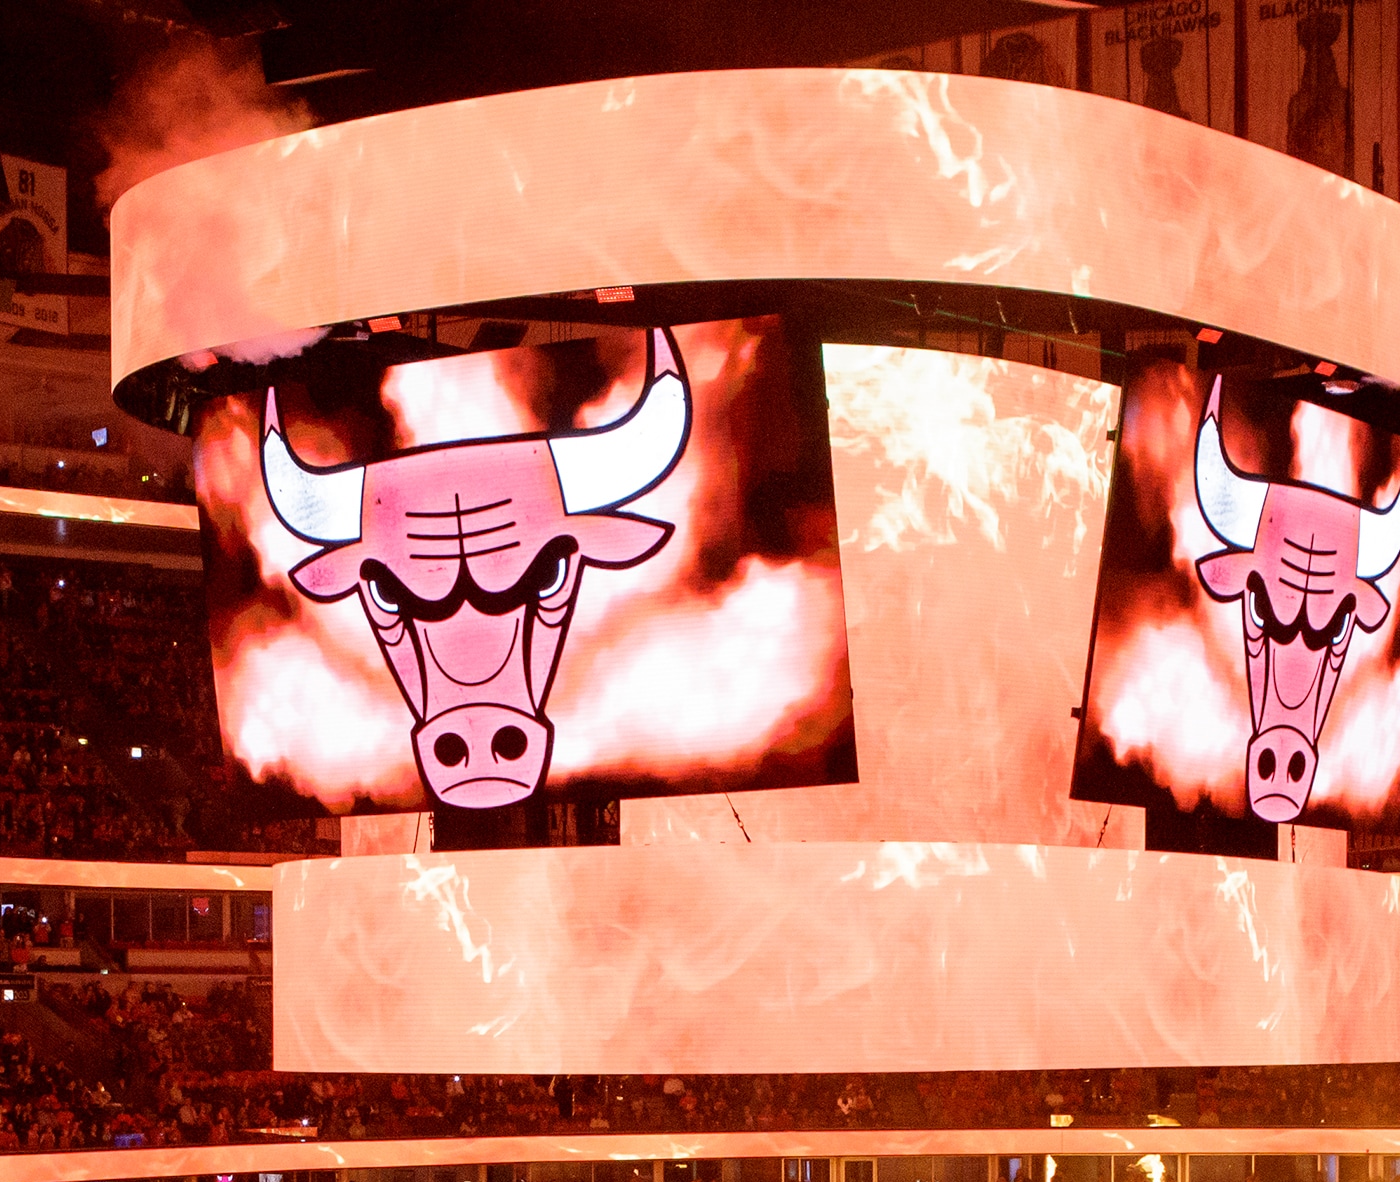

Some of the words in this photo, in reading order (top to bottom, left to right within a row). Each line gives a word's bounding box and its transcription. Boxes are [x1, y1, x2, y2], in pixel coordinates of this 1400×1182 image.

[1126, 2, 1201, 25] CHICAGO
[1104, 12, 1221, 45] BLACKHAWKS
[18, 169, 36, 196] 81
